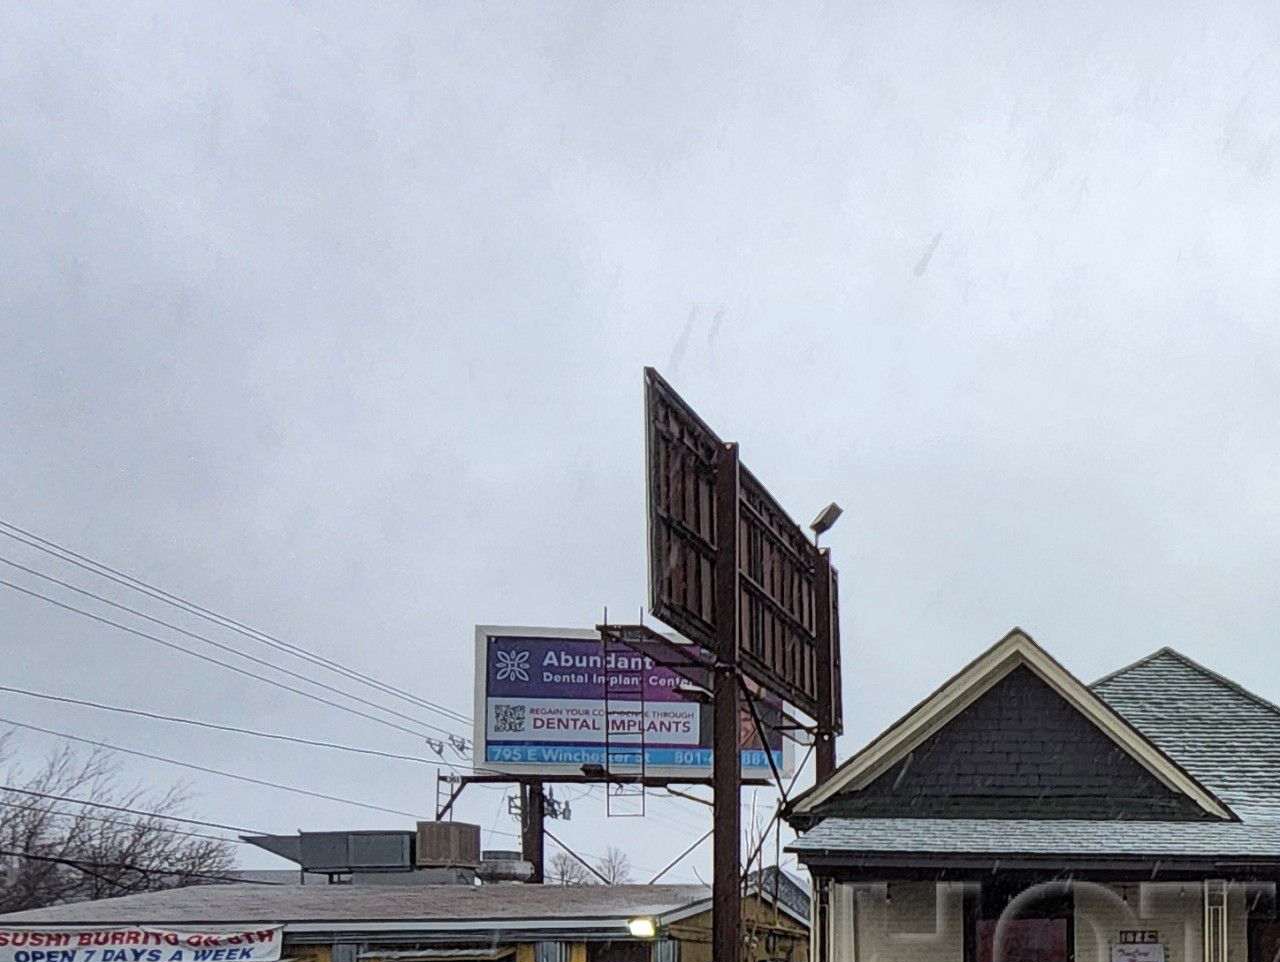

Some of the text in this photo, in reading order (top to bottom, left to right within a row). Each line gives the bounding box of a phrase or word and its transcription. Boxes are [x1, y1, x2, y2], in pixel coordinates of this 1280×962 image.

[542, 651, 653, 671] Abundant
[542, 671, 588, 684] Dental
[529, 707, 563, 716] REGAIN
[565, 708, 591, 717] YOUR
[652, 711, 695, 720] THROUGH
[532, 717, 691, 733] DENTAL IMPLANTS
[493, 748, 522, 762] 795
[527, 749, 538, 761] E
[0, 932, 69, 947] SUSHI
[78, 931, 181, 947] BURRITO
[83, 951, 95, 962] 7
[168, 951, 184, 962] A
[193, 947, 254, 962] WEEK
